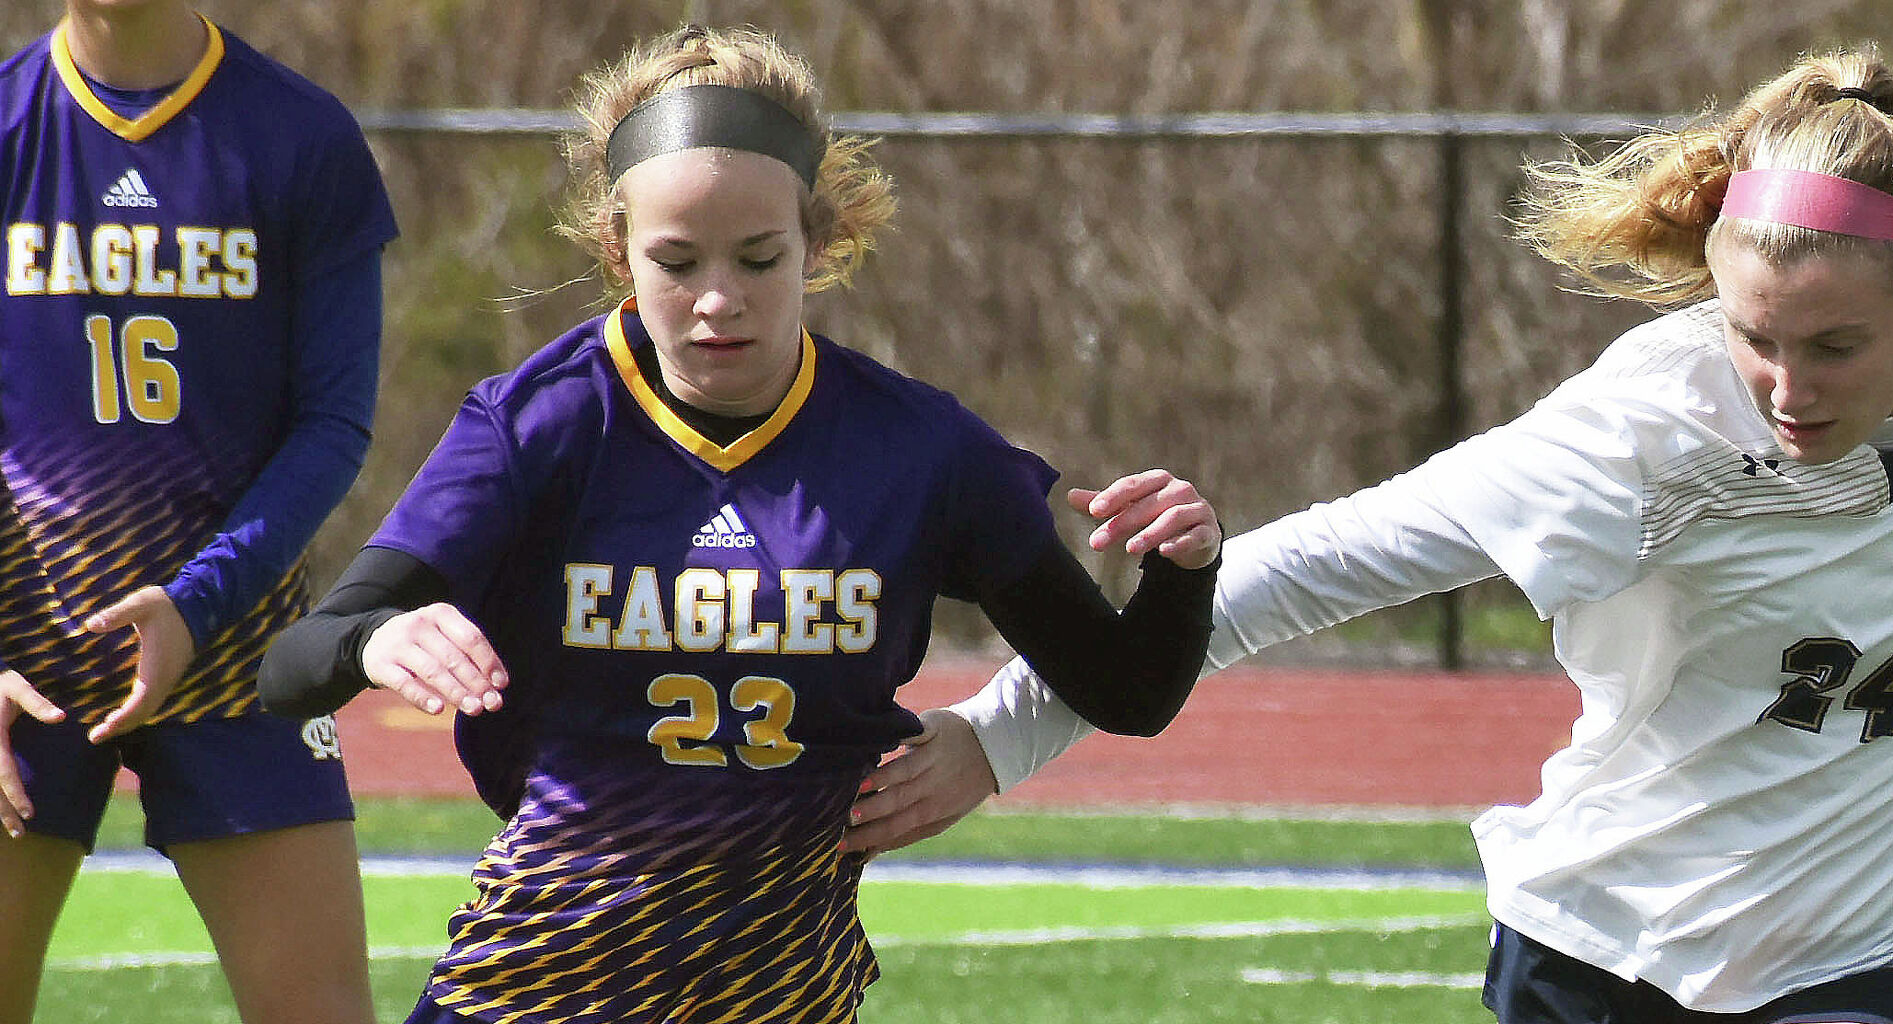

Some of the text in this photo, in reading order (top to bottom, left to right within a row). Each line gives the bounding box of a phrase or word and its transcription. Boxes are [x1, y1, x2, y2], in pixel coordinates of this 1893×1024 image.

[102, 193, 158, 208] adidas
[7, 221, 260, 300] EAGLES
[85, 314, 182, 425] 16
[692, 531, 756, 549] adidas
[562, 562, 882, 655] EAGLES
[646, 673, 805, 771] 23
